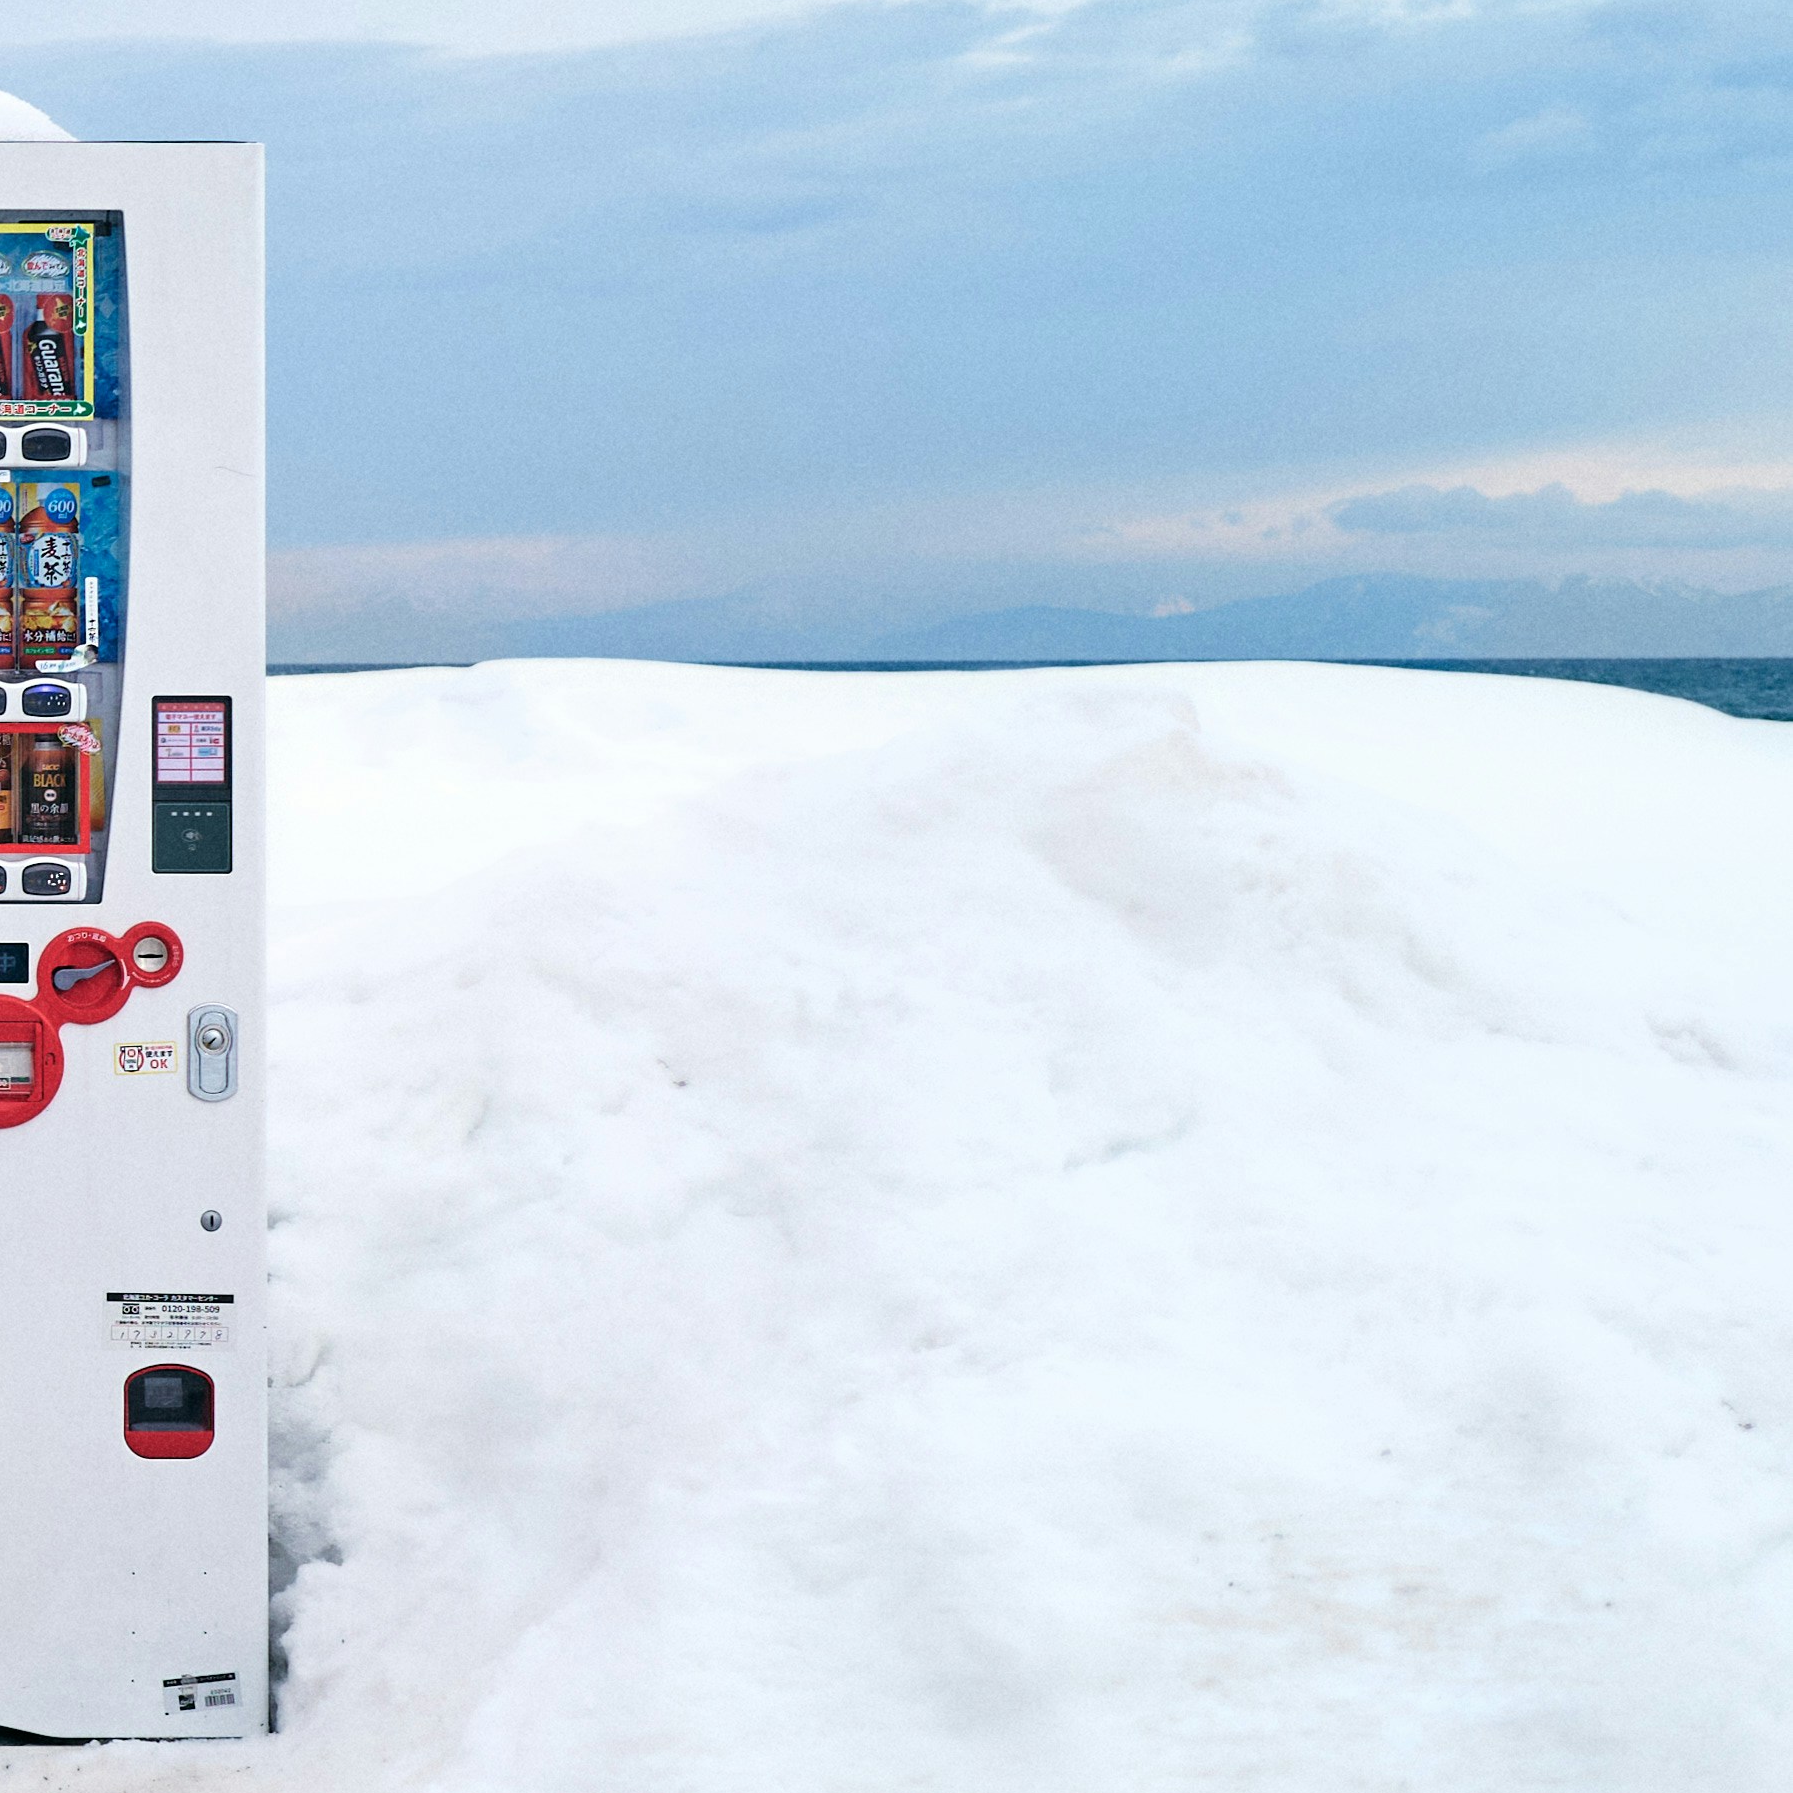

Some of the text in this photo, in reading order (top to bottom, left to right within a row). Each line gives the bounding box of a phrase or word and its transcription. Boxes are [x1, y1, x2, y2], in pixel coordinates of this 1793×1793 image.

[75, 247, 87, 318] 北海道コーナー
[48, 499, 76, 513] 600
[40, 537, 63, 585] 麦茶
[24, 629, 76, 643] 水分補給に!
[33, 773, 66, 788] BLACK
[149, 1059, 168, 1070] OK
[161, 1304, 221, 1314] 0120-198-509
